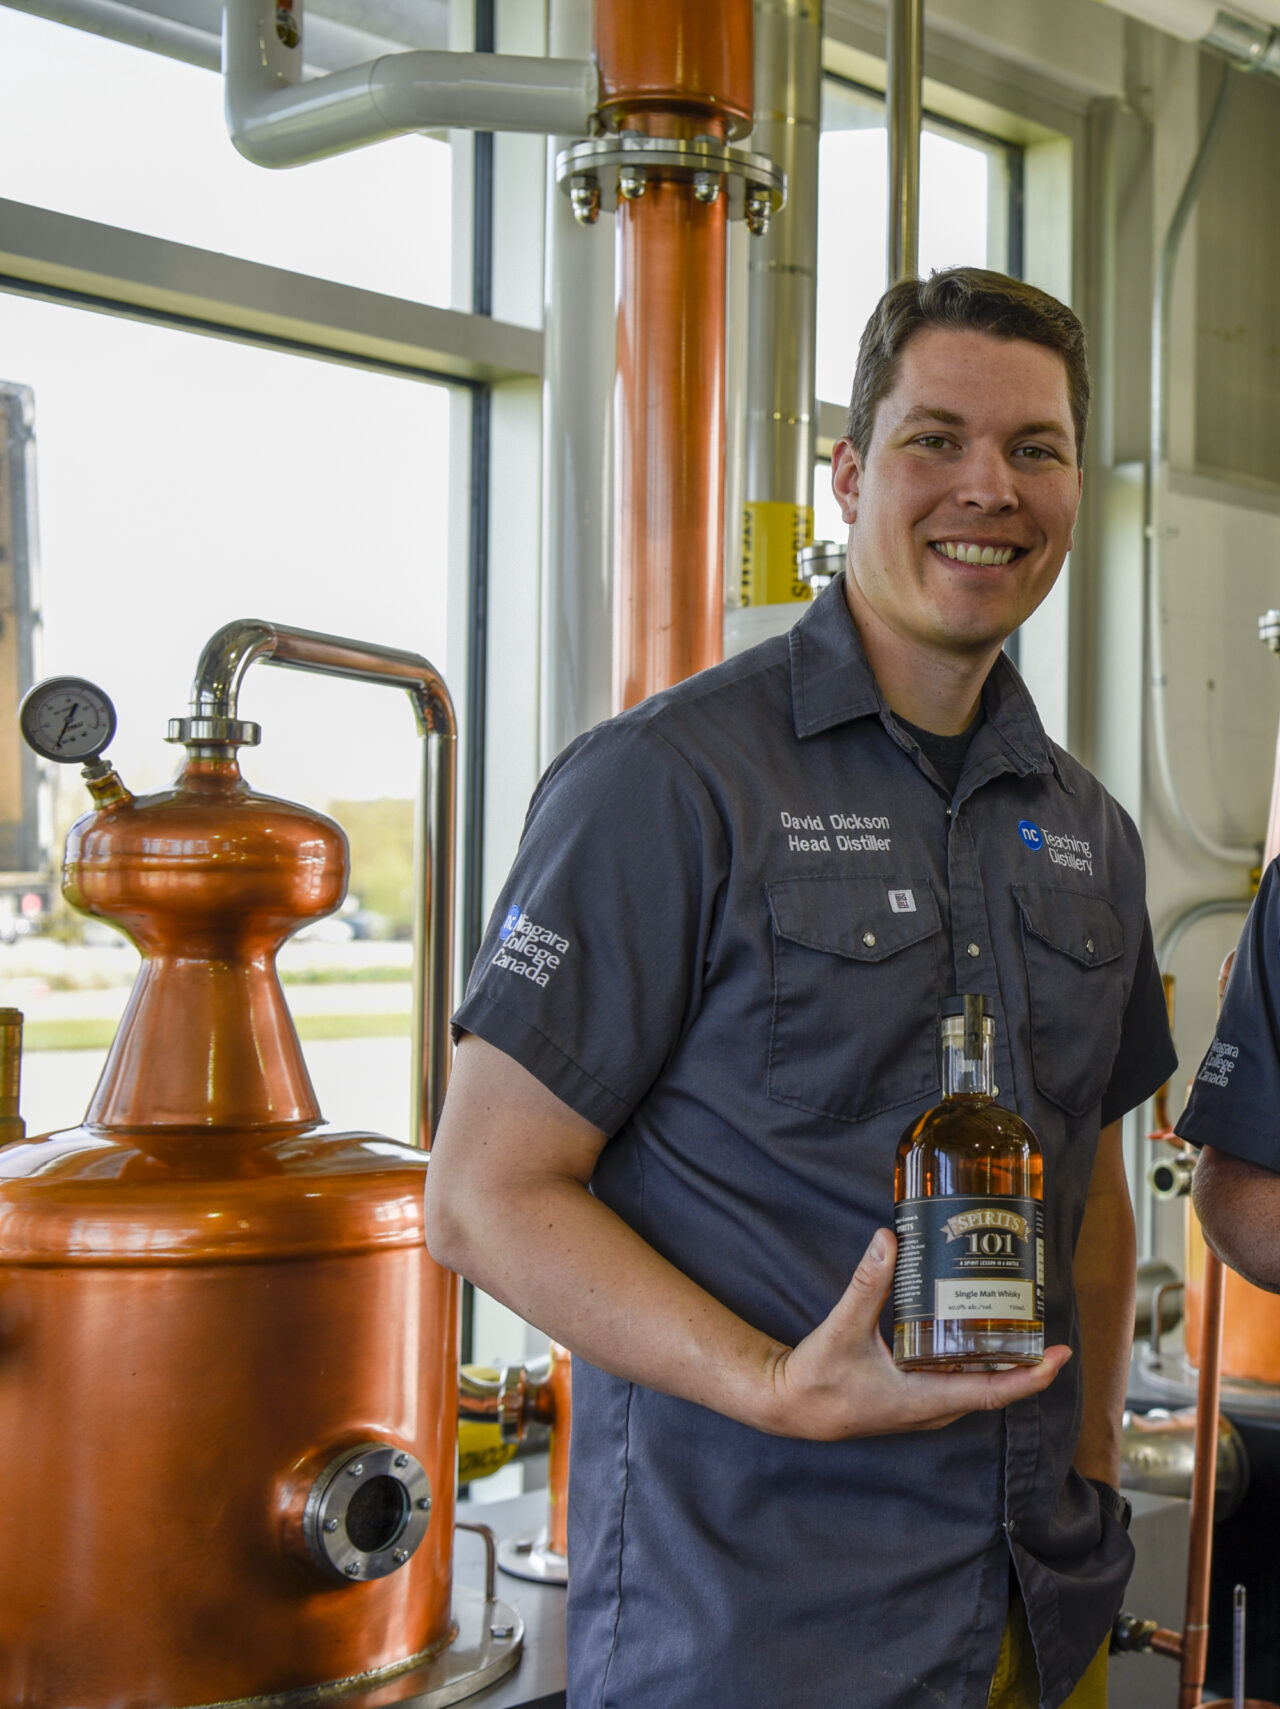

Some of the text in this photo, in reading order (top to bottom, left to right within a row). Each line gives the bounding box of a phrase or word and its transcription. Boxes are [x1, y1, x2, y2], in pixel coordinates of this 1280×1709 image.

[780, 811, 890, 831] David Dickson
[788, 834, 891, 852] Head Distiller
[1021, 827, 1040, 842] nc
[1040, 827, 1093, 859] Teaching
[1048, 847, 1093, 876] Distillery
[515, 913, 570, 954] Niagara
[502, 931, 561, 970] College
[492, 947, 550, 988] Canada
[957, 1210, 1021, 1231] SPIRITS
[965, 1232, 1016, 1255] 101
[954, 1290, 1021, 1300] Single Malt Whisky
